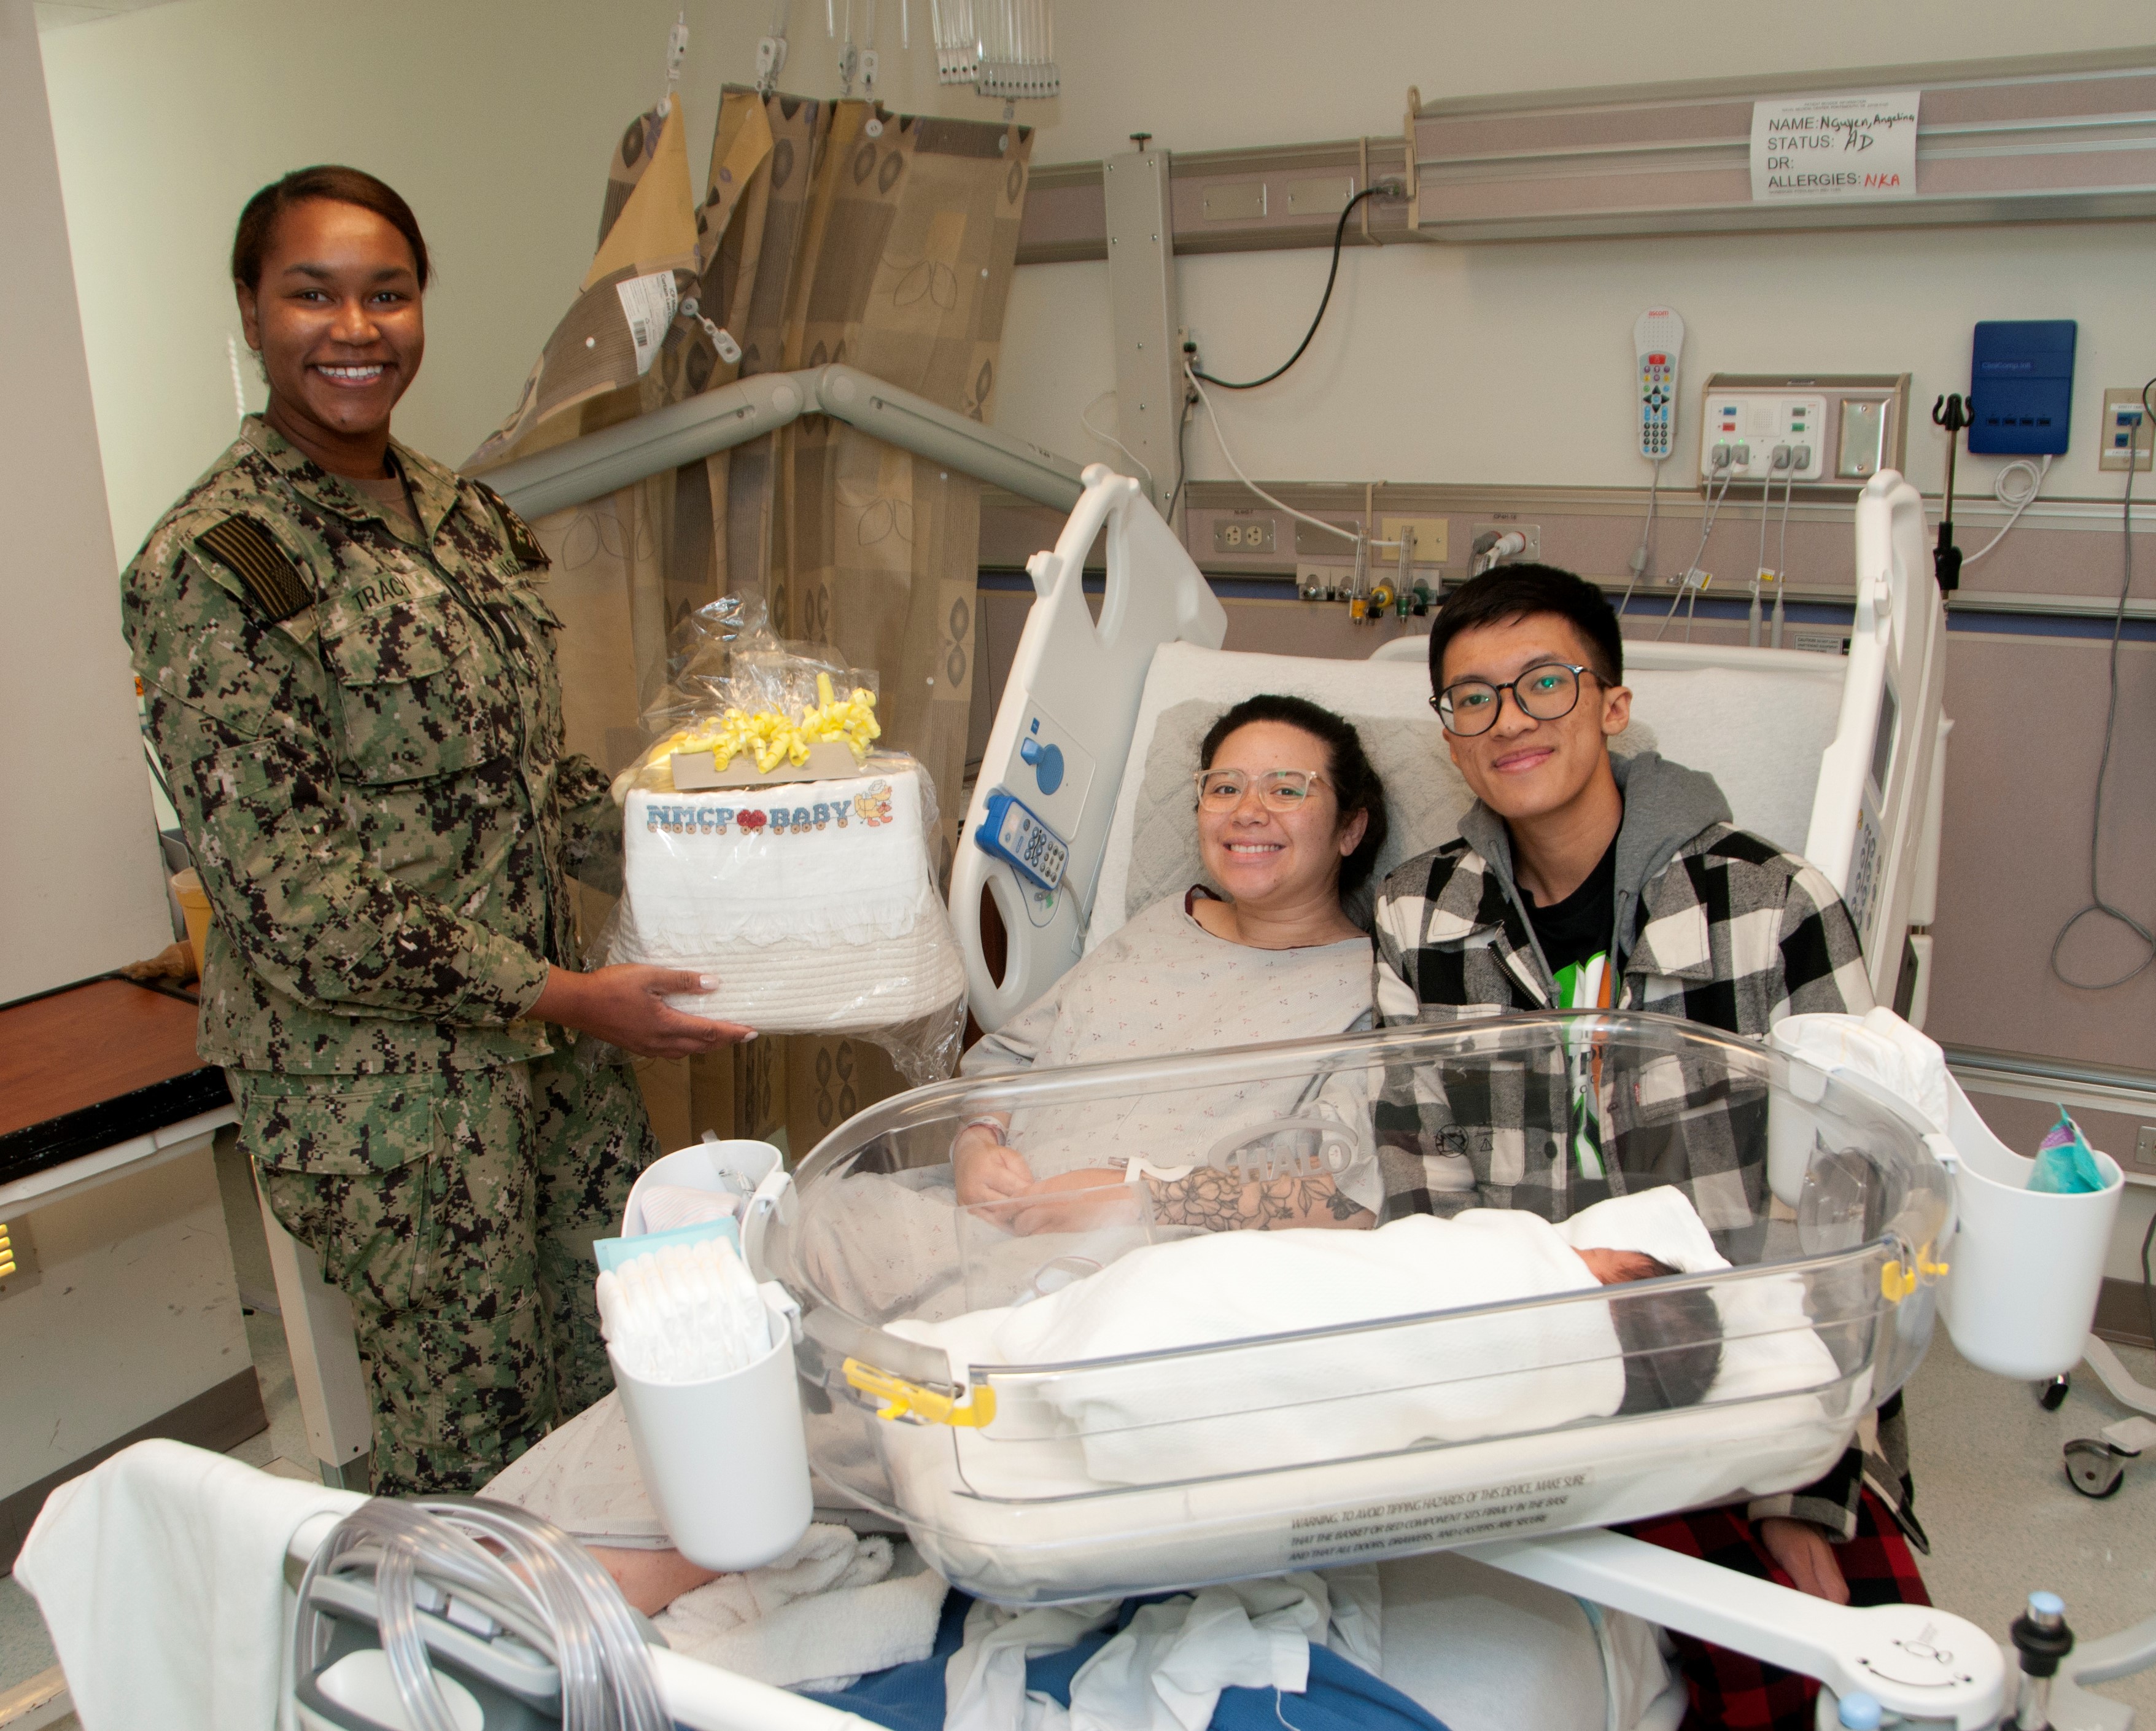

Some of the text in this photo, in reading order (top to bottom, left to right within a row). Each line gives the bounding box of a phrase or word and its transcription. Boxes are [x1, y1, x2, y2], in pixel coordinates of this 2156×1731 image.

[1769, 117, 1818, 130] NAME:
[1768, 130, 1874, 152] STATUS: AD
[1768, 157, 1793, 170] DR:
[1768, 173, 1900, 189] ALLERGIES: NKA
[352, 576, 411, 612] TRACY
[646, 800, 851, 828] NMCP BABY
[1236, 1139, 1351, 1184] HALO
